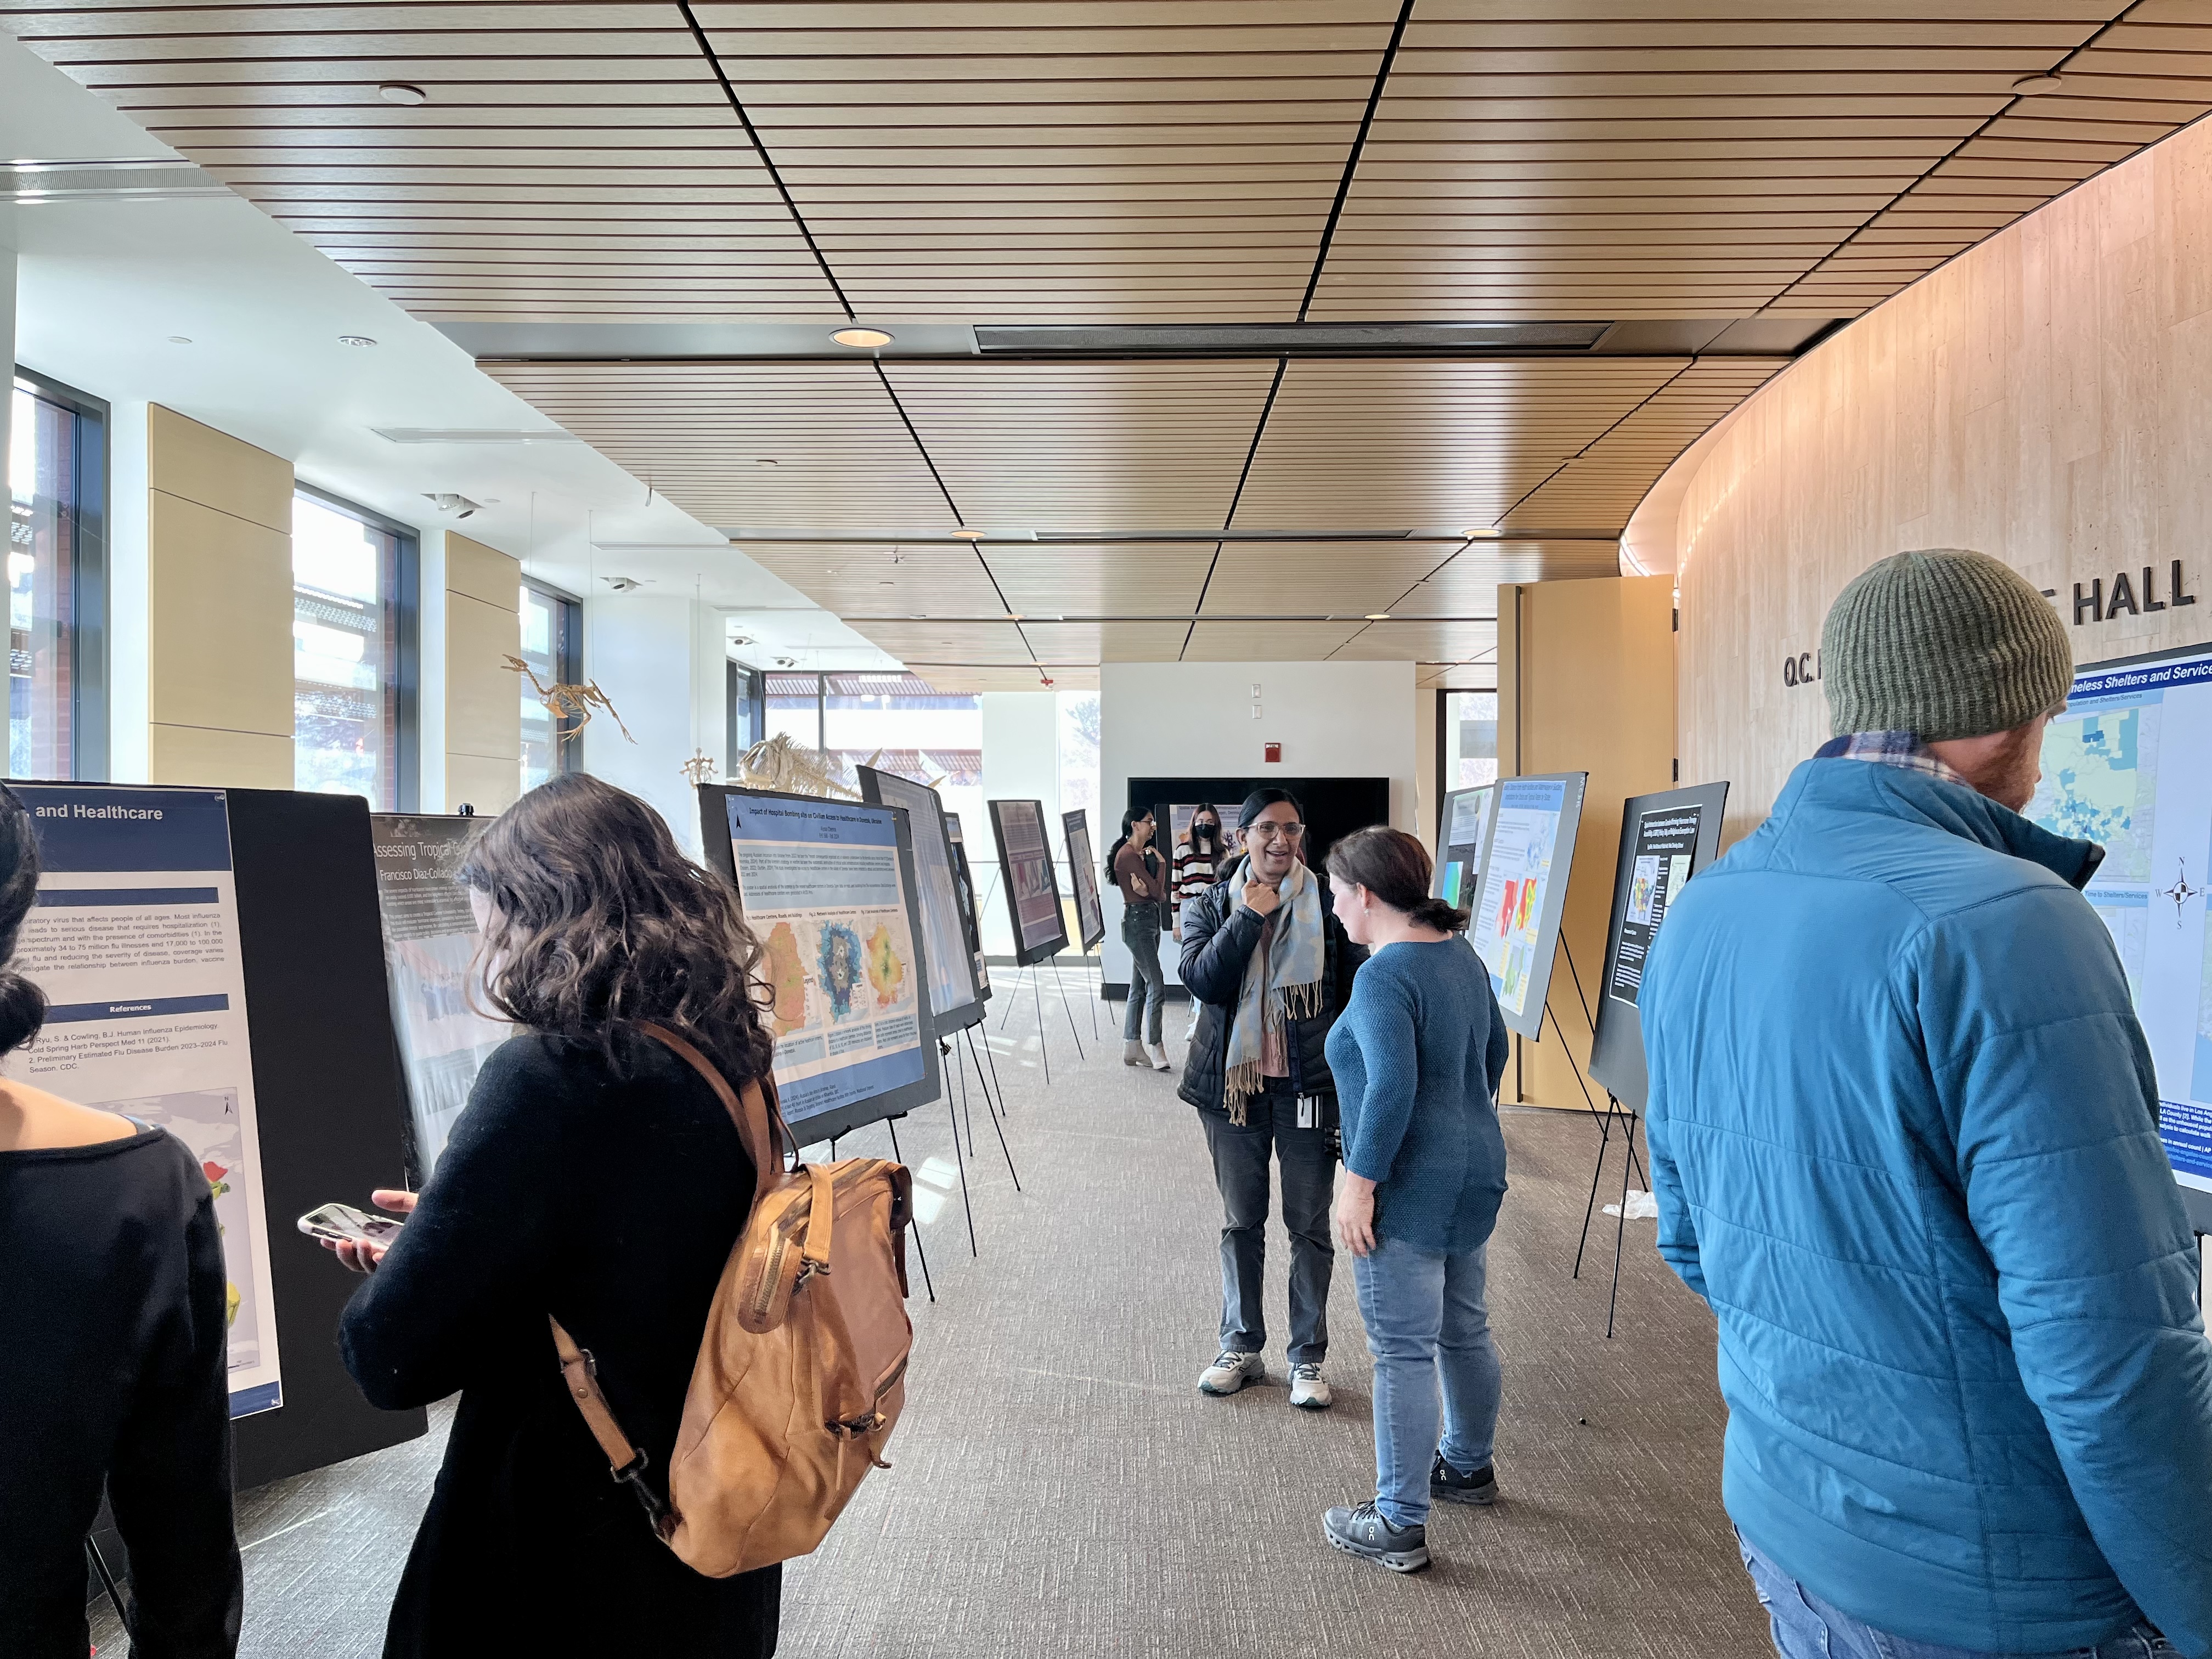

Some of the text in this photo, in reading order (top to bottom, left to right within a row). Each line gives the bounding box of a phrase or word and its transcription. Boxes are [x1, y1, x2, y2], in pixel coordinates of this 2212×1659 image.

[2073, 559, 2195, 625] HALL
[2070, 663, 2212, 693] meless Shelters and Service
[2100, 693, 2142, 703] Shelters/Services
[36, 804, 163, 820] and Healthcare
[749, 807, 763, 816] Impact
[768, 809, 783, 817] Hospital
[785, 810, 800, 819] Bombing
[374, 842, 417, 860] Assessing
[417, 841, 452, 860] Tropical
[2179, 857, 2185, 866] N
[380, 868, 412, 881] Francisco
[2155, 887, 2205, 898] W E
[24, 917, 50, 925] piratory
[2177, 921, 2182, 930] S
[106, 934, 136, 942] presence
[110, 1005, 152, 1013] References
[46, 1045, 69, 1053] Spring
[90, 1041, 120, 1049] Perspect
[78, 1051, 112, 1059] Estimated
[2166, 1109, 2182, 1119] County
